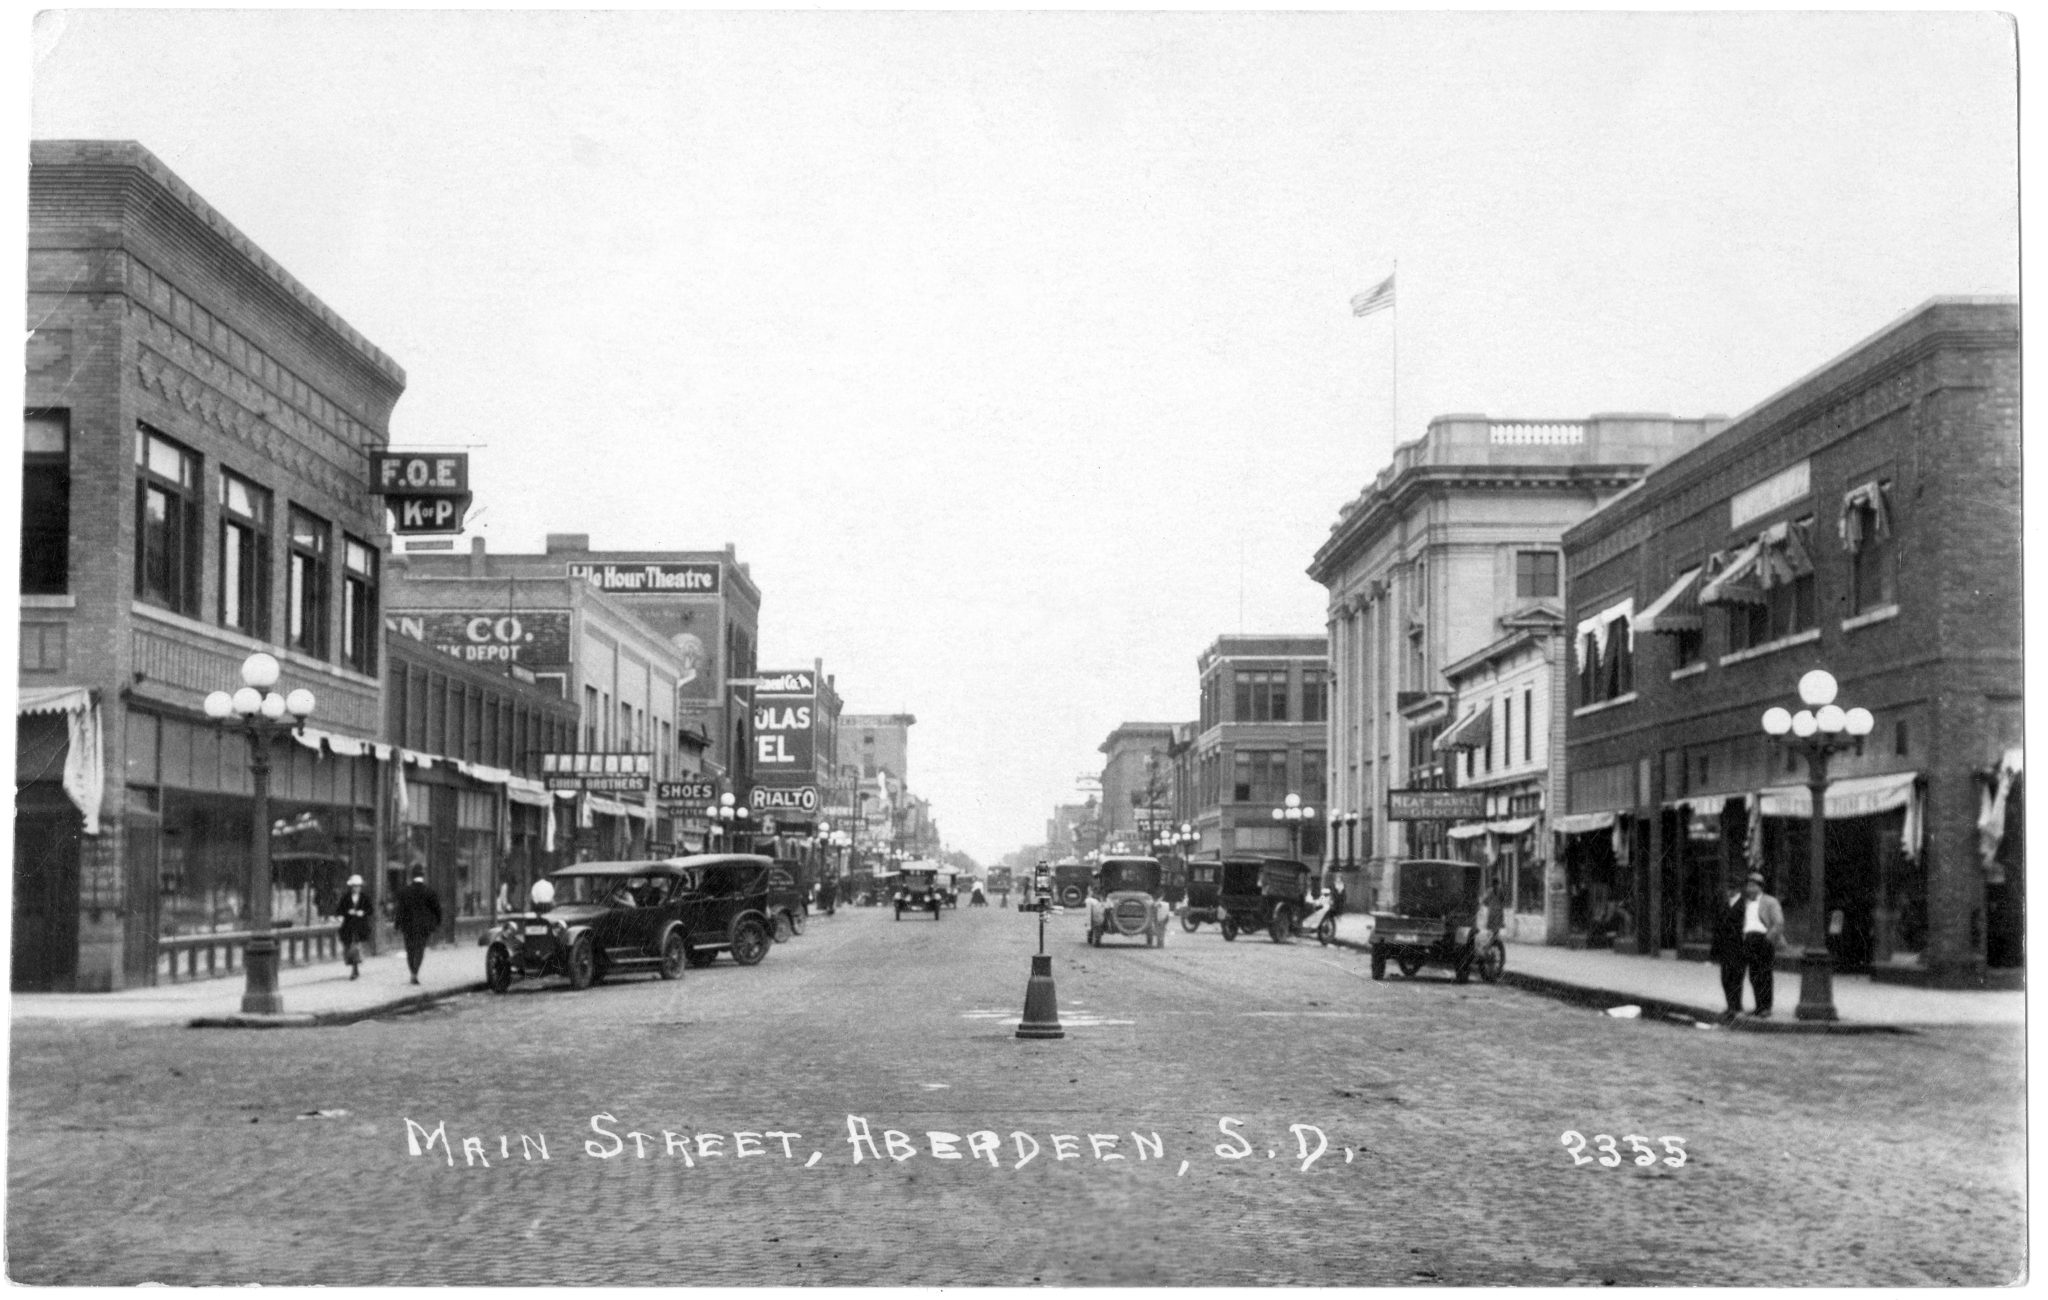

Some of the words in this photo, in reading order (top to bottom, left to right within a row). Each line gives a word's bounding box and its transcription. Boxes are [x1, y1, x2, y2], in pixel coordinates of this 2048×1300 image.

[382, 459, 456, 487] F.O.E
[403, 500, 423, 526] K
[435, 500, 453, 526] P
[604, 566, 646, 588] Hour
[645, 566, 712, 588] Theatre
[466, 617, 534, 642] CO.
[466, 645, 520, 660] DEPOT
[754, 735, 795, 762] EL
[586, 778, 644, 789] BROTHERS
[661, 784, 713, 798] SHOES
[754, 789, 815, 808] RIALTO
